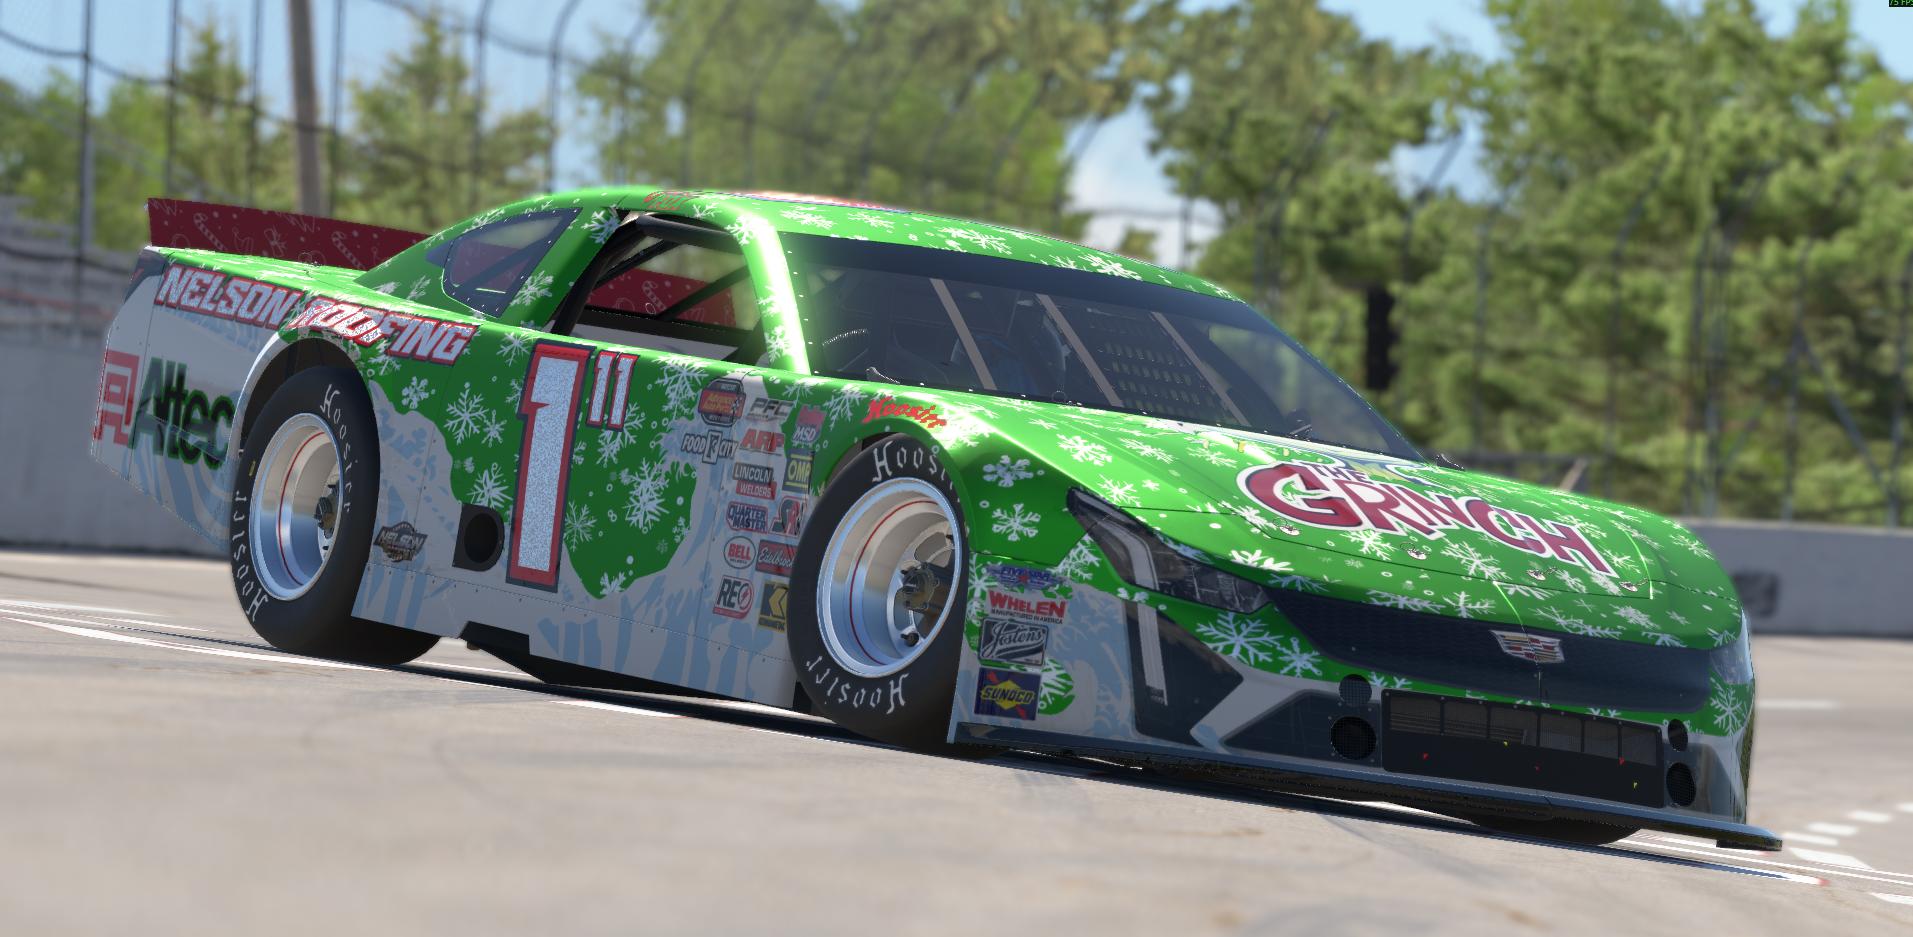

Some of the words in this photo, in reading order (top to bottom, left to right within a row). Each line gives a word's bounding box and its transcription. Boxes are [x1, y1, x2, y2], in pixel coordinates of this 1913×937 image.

[154, 264, 303, 329] NELSON
[287, 297, 480, 365] ROOFING
[127, 357, 236, 470] Altec
[740, 428, 785, 453] ARP
[792, 425, 817, 443] MSD
[681, 433, 705, 454] FOOD
[719, 438, 739, 459] CITY
[507, 341, 597, 593] 1
[586, 350, 639, 432] 11
[735, 464, 772, 482] LINCOLN
[1299, 462, 1374, 484] THE
[740, 481, 772, 497] WELDERS
[728, 505, 767, 519] QUARTER
[1240, 464, 1618, 577] GRINCH
[733, 516, 767, 531] MASTER
[728, 543, 751, 561] BELL
[989, 590, 1067, 618] WHELEN
[992, 608, 1033, 621] MANUFACTURED
[1040, 616, 1063, 625] AMERICA
[983, 687, 1034, 704] SUNOCO
